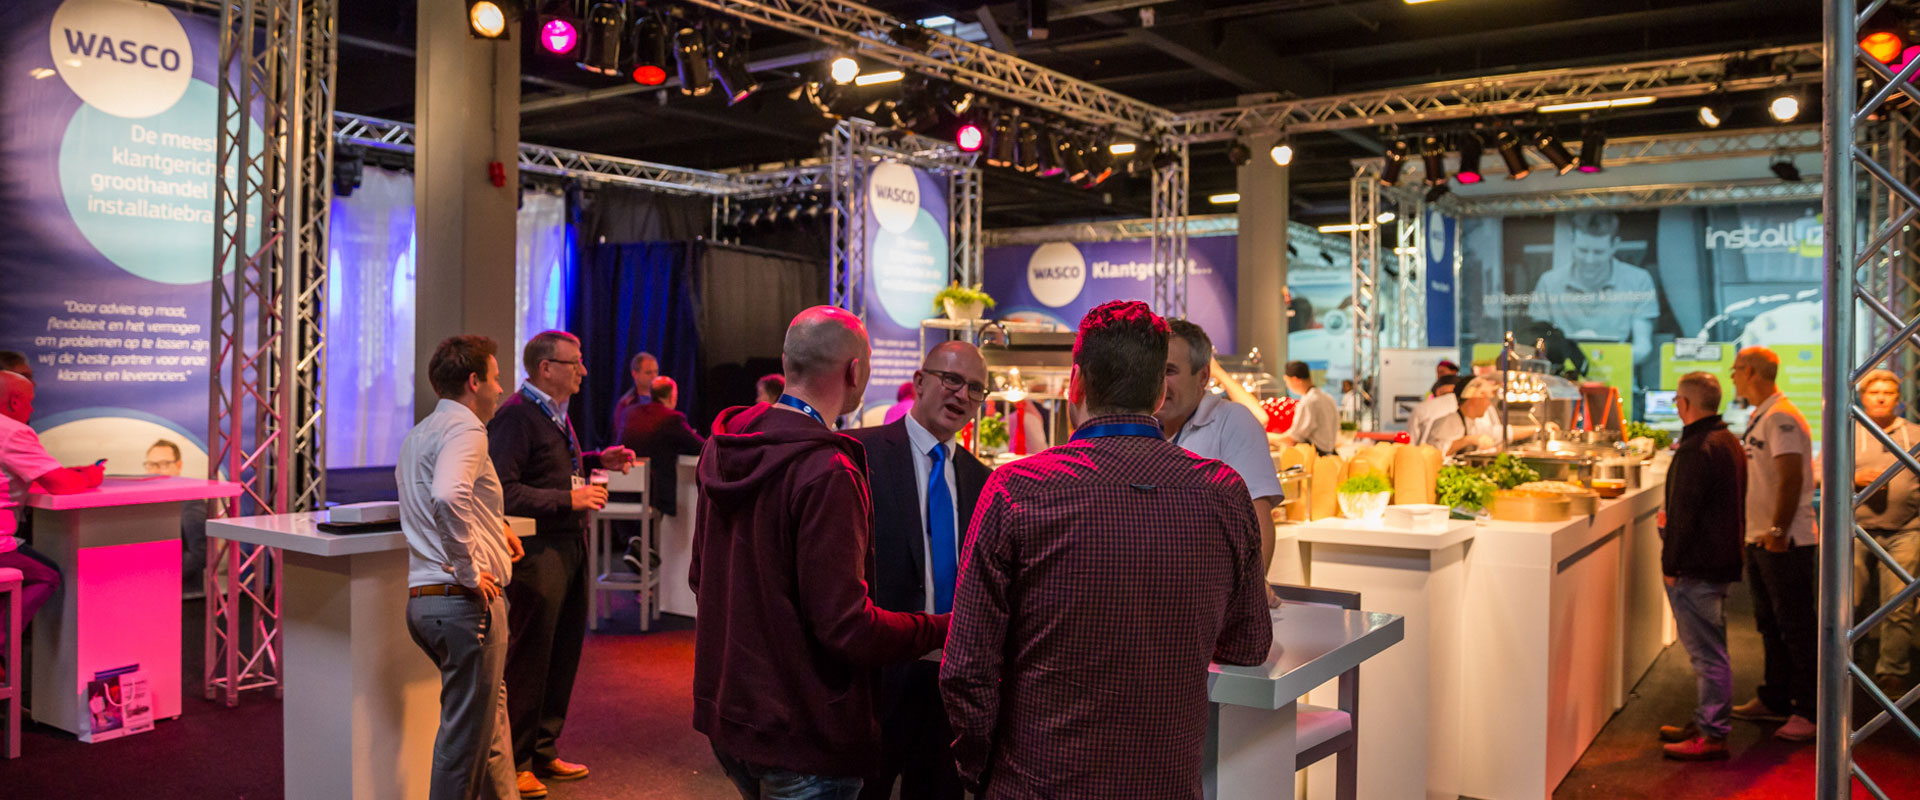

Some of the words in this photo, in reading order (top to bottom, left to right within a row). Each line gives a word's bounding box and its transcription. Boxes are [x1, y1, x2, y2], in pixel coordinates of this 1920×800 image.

[64, 29, 181, 71] WASCO
[131, 124, 158, 145] De
[112, 146, 236, 179] klantgeriche
[91, 173, 208, 200] groothandel
[875, 184, 915, 204] WASCO
[1705, 222, 1796, 249] install
[1033, 266, 1080, 280] WASCO
[99, 302, 136, 315] advies
[138, 305, 154, 318] op
[155, 306, 187, 319] maat,
[47, 316, 106, 331] flexibiliteit
[108, 321, 124, 331] en
[125, 319, 145, 332] het
[147, 323, 200, 336] vermogen
[35, 336, 57, 347] om
[58, 335, 122, 349] problemen
[124, 338, 140, 350] op
[141, 337, 154, 349] te
[155, 337, 190, 349] lossen
[38, 352, 56, 366] wij
[58, 352, 75, 364] de
[77, 352, 110, 365] beste
[111, 354, 153, 366] partner
[155, 355, 180, 366] voor
[181, 355, 207, 366] onze
[58, 368, 102, 381] klanten
[104, 371, 120, 381] en
